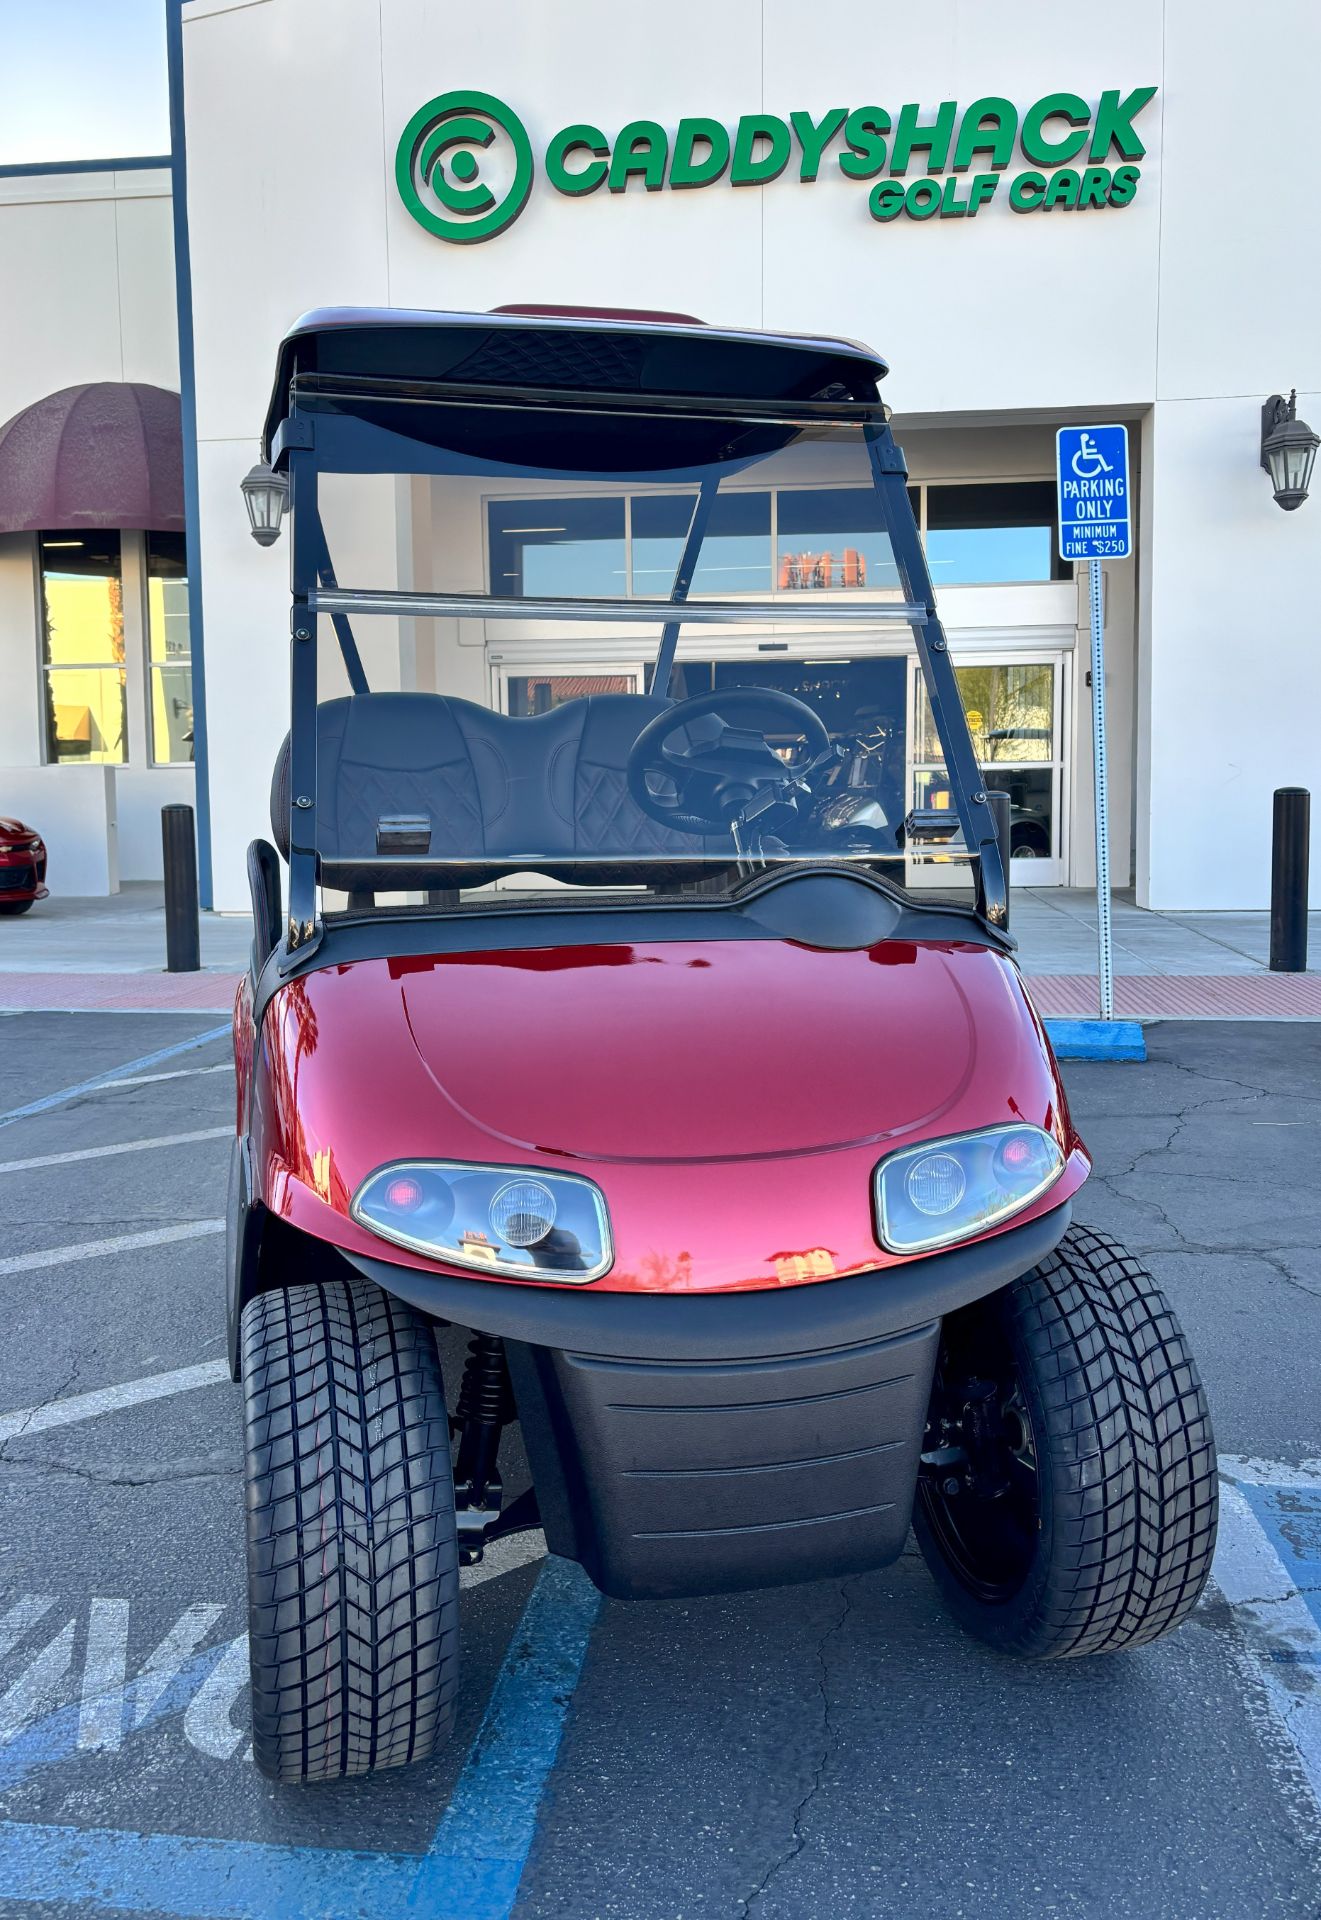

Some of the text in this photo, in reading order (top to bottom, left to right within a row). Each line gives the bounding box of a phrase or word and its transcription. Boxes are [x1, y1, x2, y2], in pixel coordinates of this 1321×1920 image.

[545, 86, 1158, 197] CADDYSHACK
[868, 166, 1141, 222] GOLF CARS
[1063, 478, 1124, 498] PARKING
[1076, 500, 1113, 519] ONLY
[1073, 525, 1117, 539] MINIMUM
[1066, 540, 1125, 554] FINE $250
